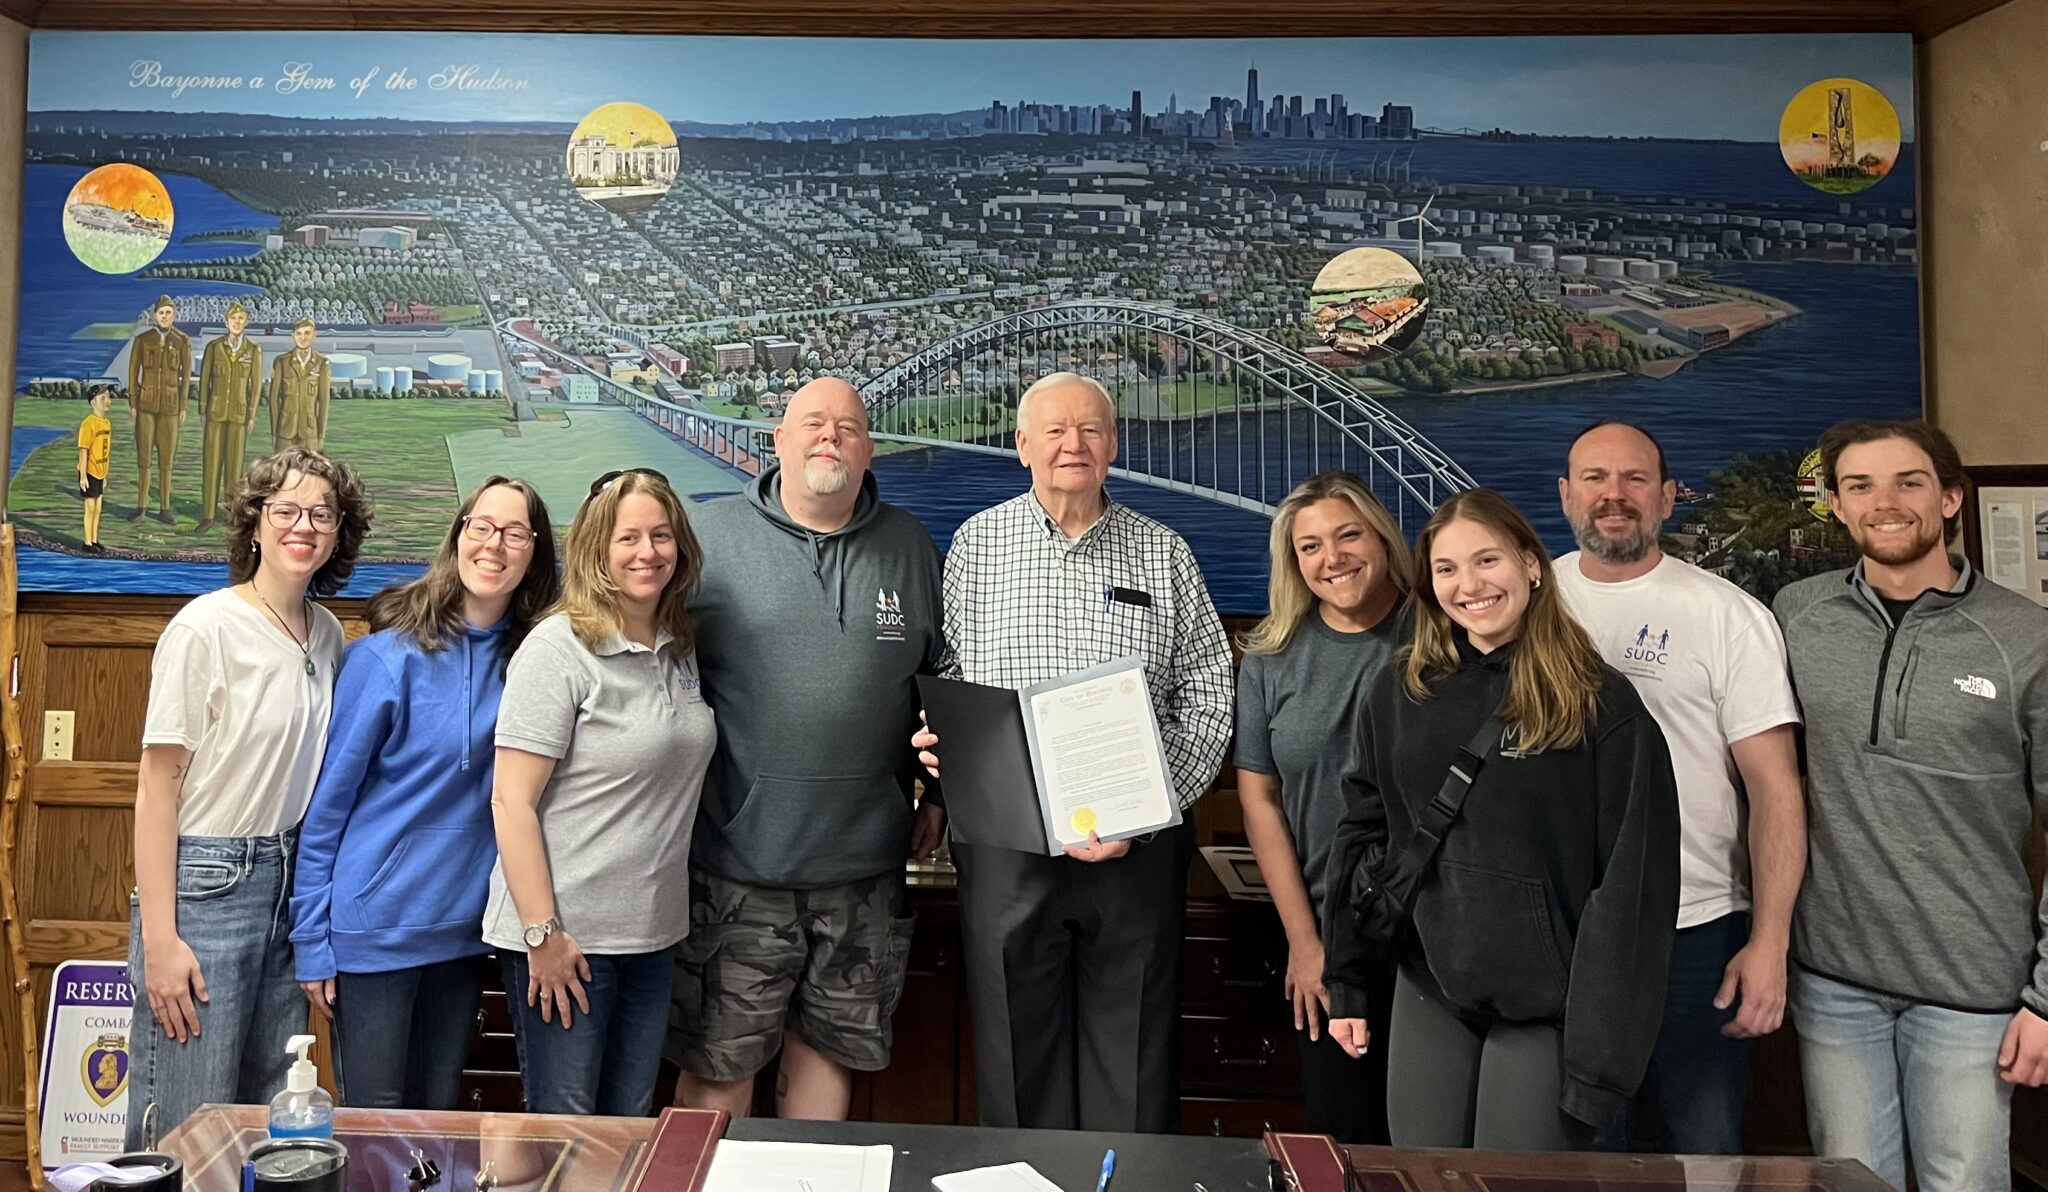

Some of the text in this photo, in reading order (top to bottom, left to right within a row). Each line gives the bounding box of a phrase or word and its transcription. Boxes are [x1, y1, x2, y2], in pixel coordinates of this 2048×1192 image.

[129, 60, 529, 99] Bayonne a Gem of the Hudson
[876, 612, 905, 626] SUDC
[1624, 647, 1668, 665] SUDC
